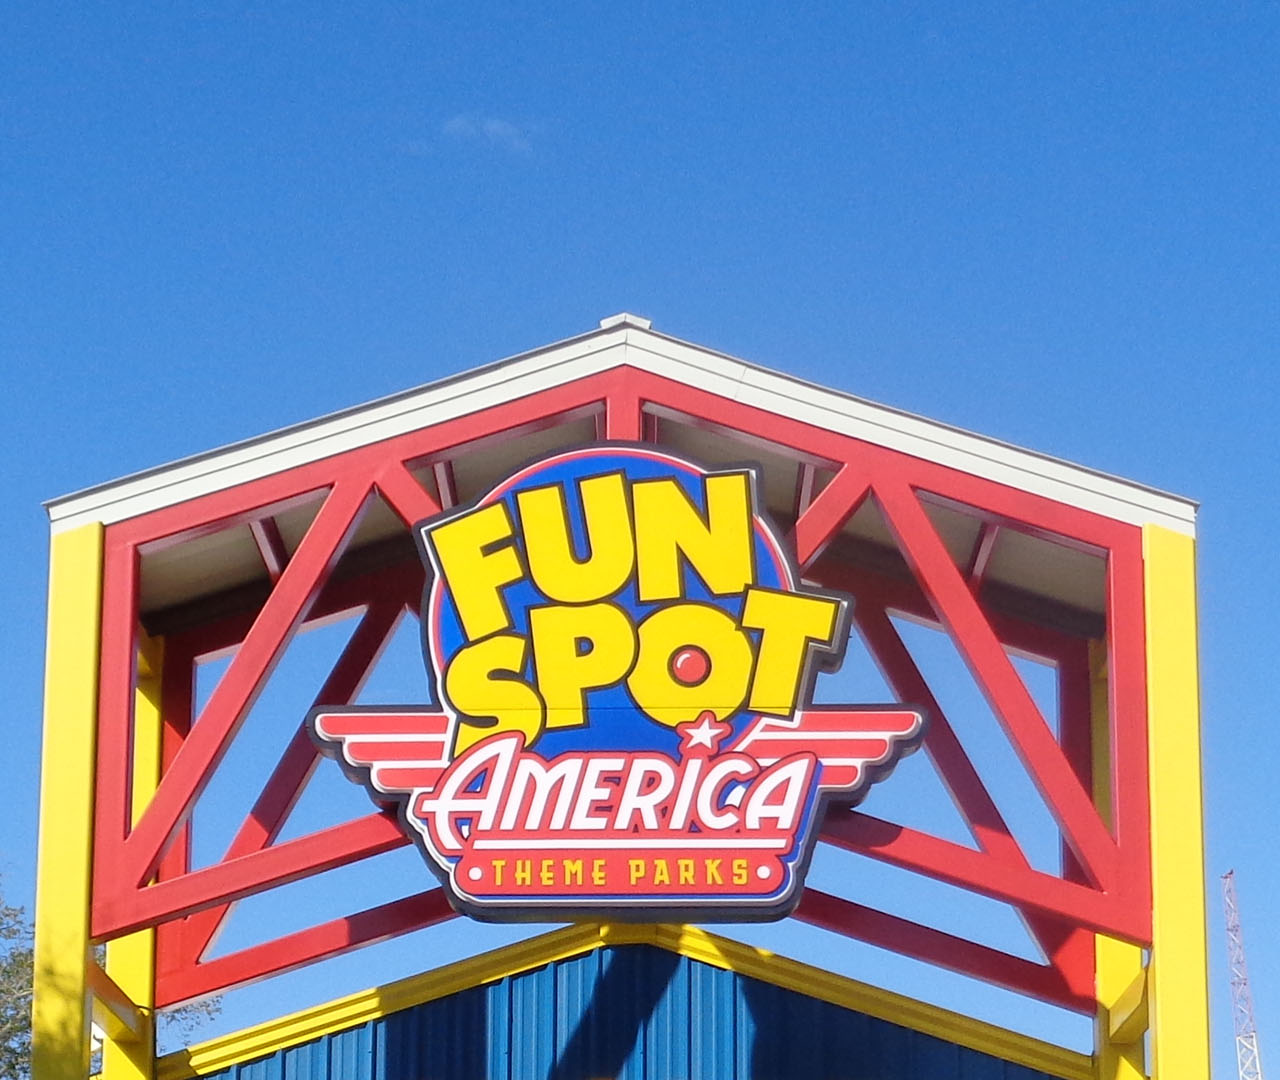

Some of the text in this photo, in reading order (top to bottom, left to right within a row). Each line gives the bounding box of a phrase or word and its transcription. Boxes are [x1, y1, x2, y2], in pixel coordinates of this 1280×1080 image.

[431, 471, 755, 641] FUN
[445, 585, 839, 758] SPOT
[420, 735, 816, 850] AMERICA
[491, 859, 749, 886] THEME PARKS
